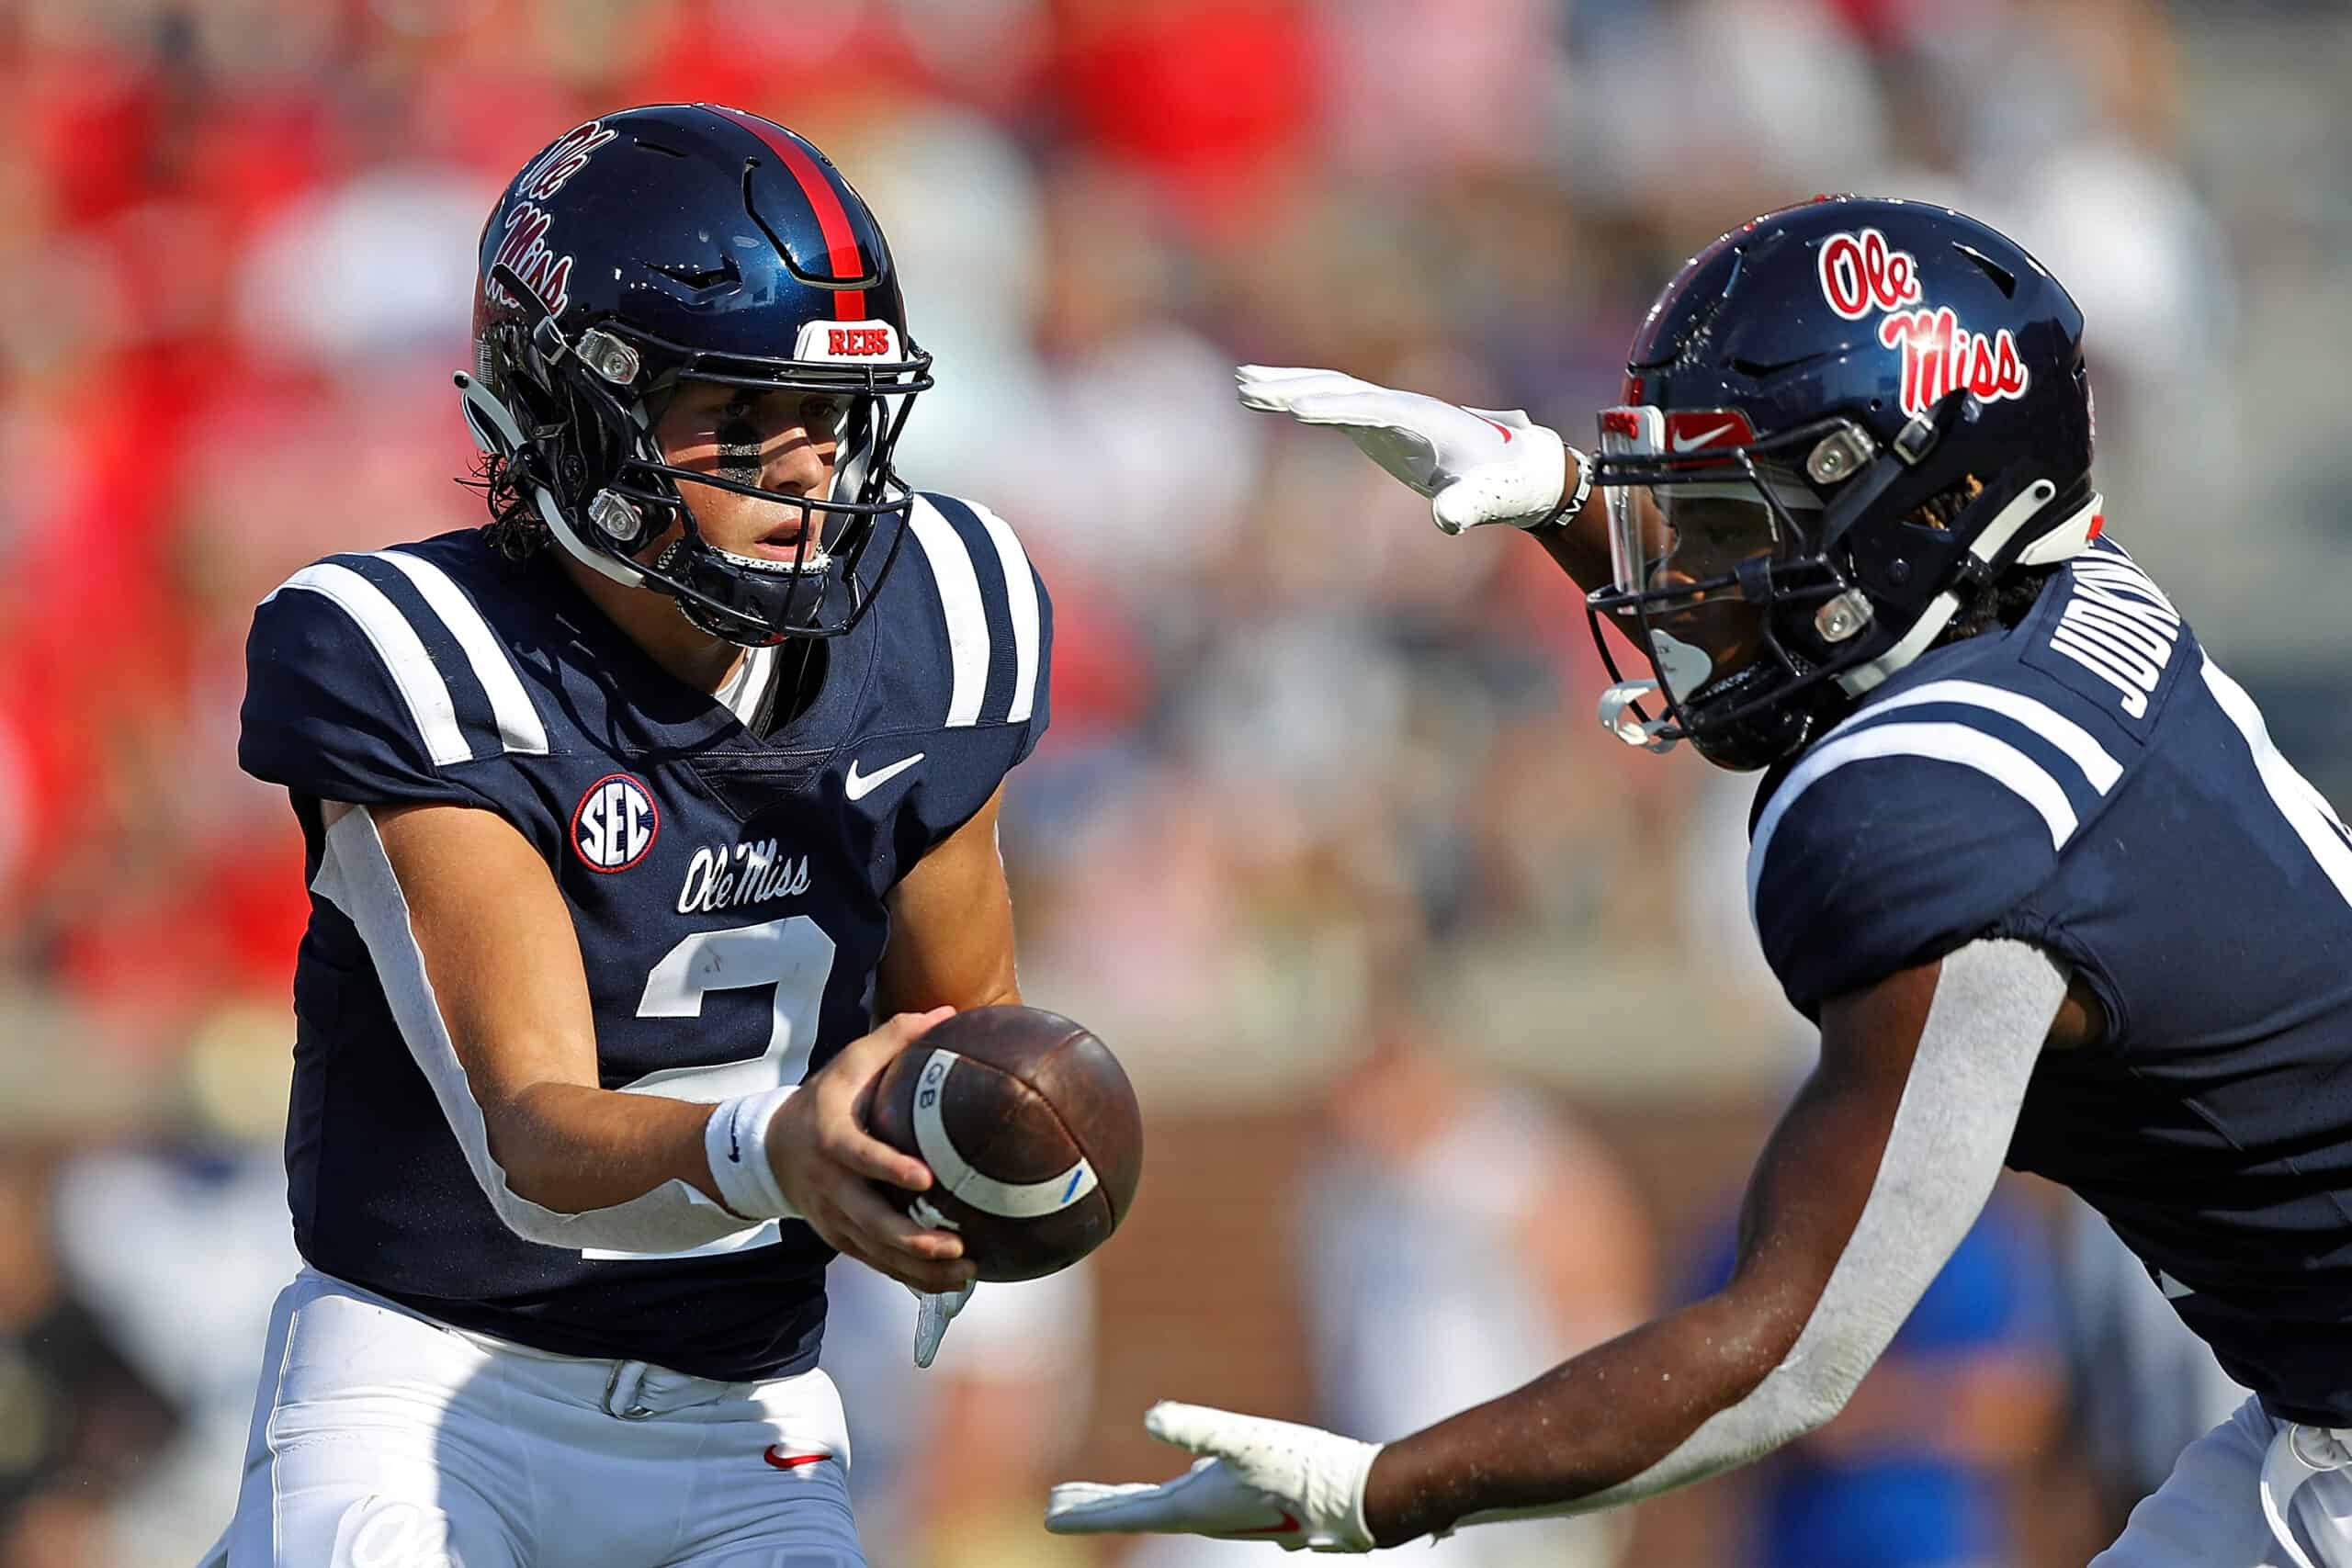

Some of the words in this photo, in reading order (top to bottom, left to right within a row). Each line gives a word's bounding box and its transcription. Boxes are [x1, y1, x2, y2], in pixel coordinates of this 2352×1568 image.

[1818, 229, 1921, 321] Ole
[828, 329, 889, 356] REBS
[1879, 305, 2029, 418] Miss
[580, 782, 651, 866] SEC
[676, 842, 734, 915] Ole
[734, 837, 812, 906] Miss
[582, 915, 837, 1260] 2
